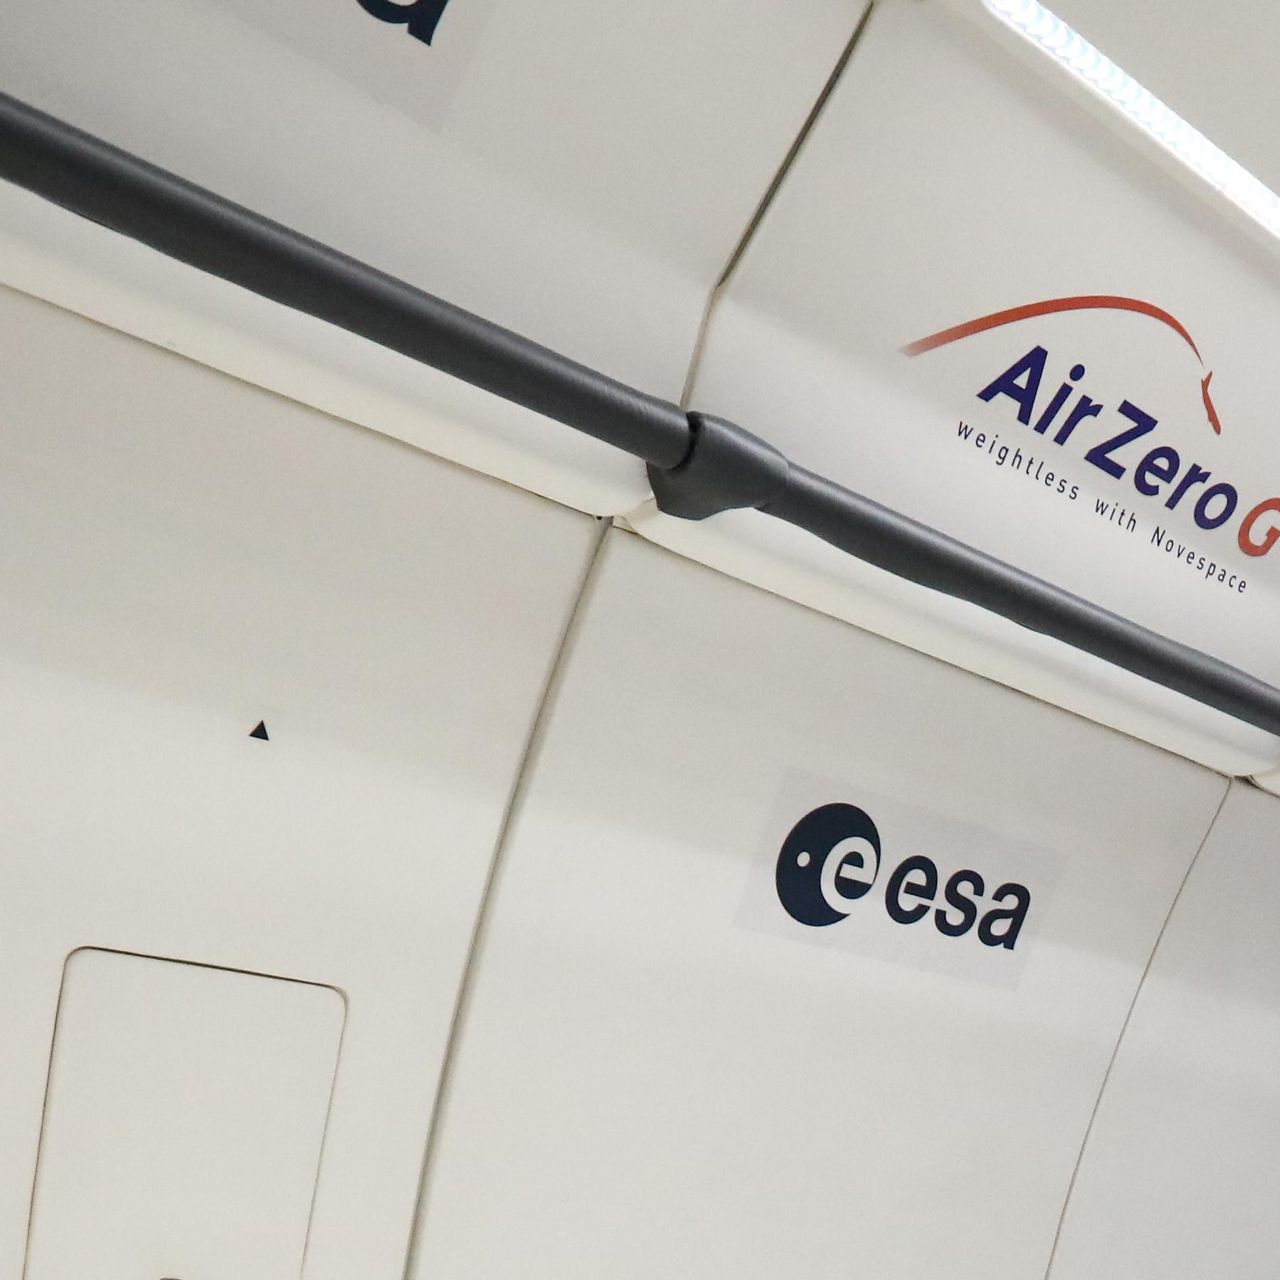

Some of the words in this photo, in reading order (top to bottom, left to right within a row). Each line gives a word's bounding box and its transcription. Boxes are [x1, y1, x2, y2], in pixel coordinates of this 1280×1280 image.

[957, 420, 1079, 500] weightless
[1094, 498, 1138, 533] with
[1150, 526, 1247, 594] Novespace
[885, 855, 1031, 950] esa
